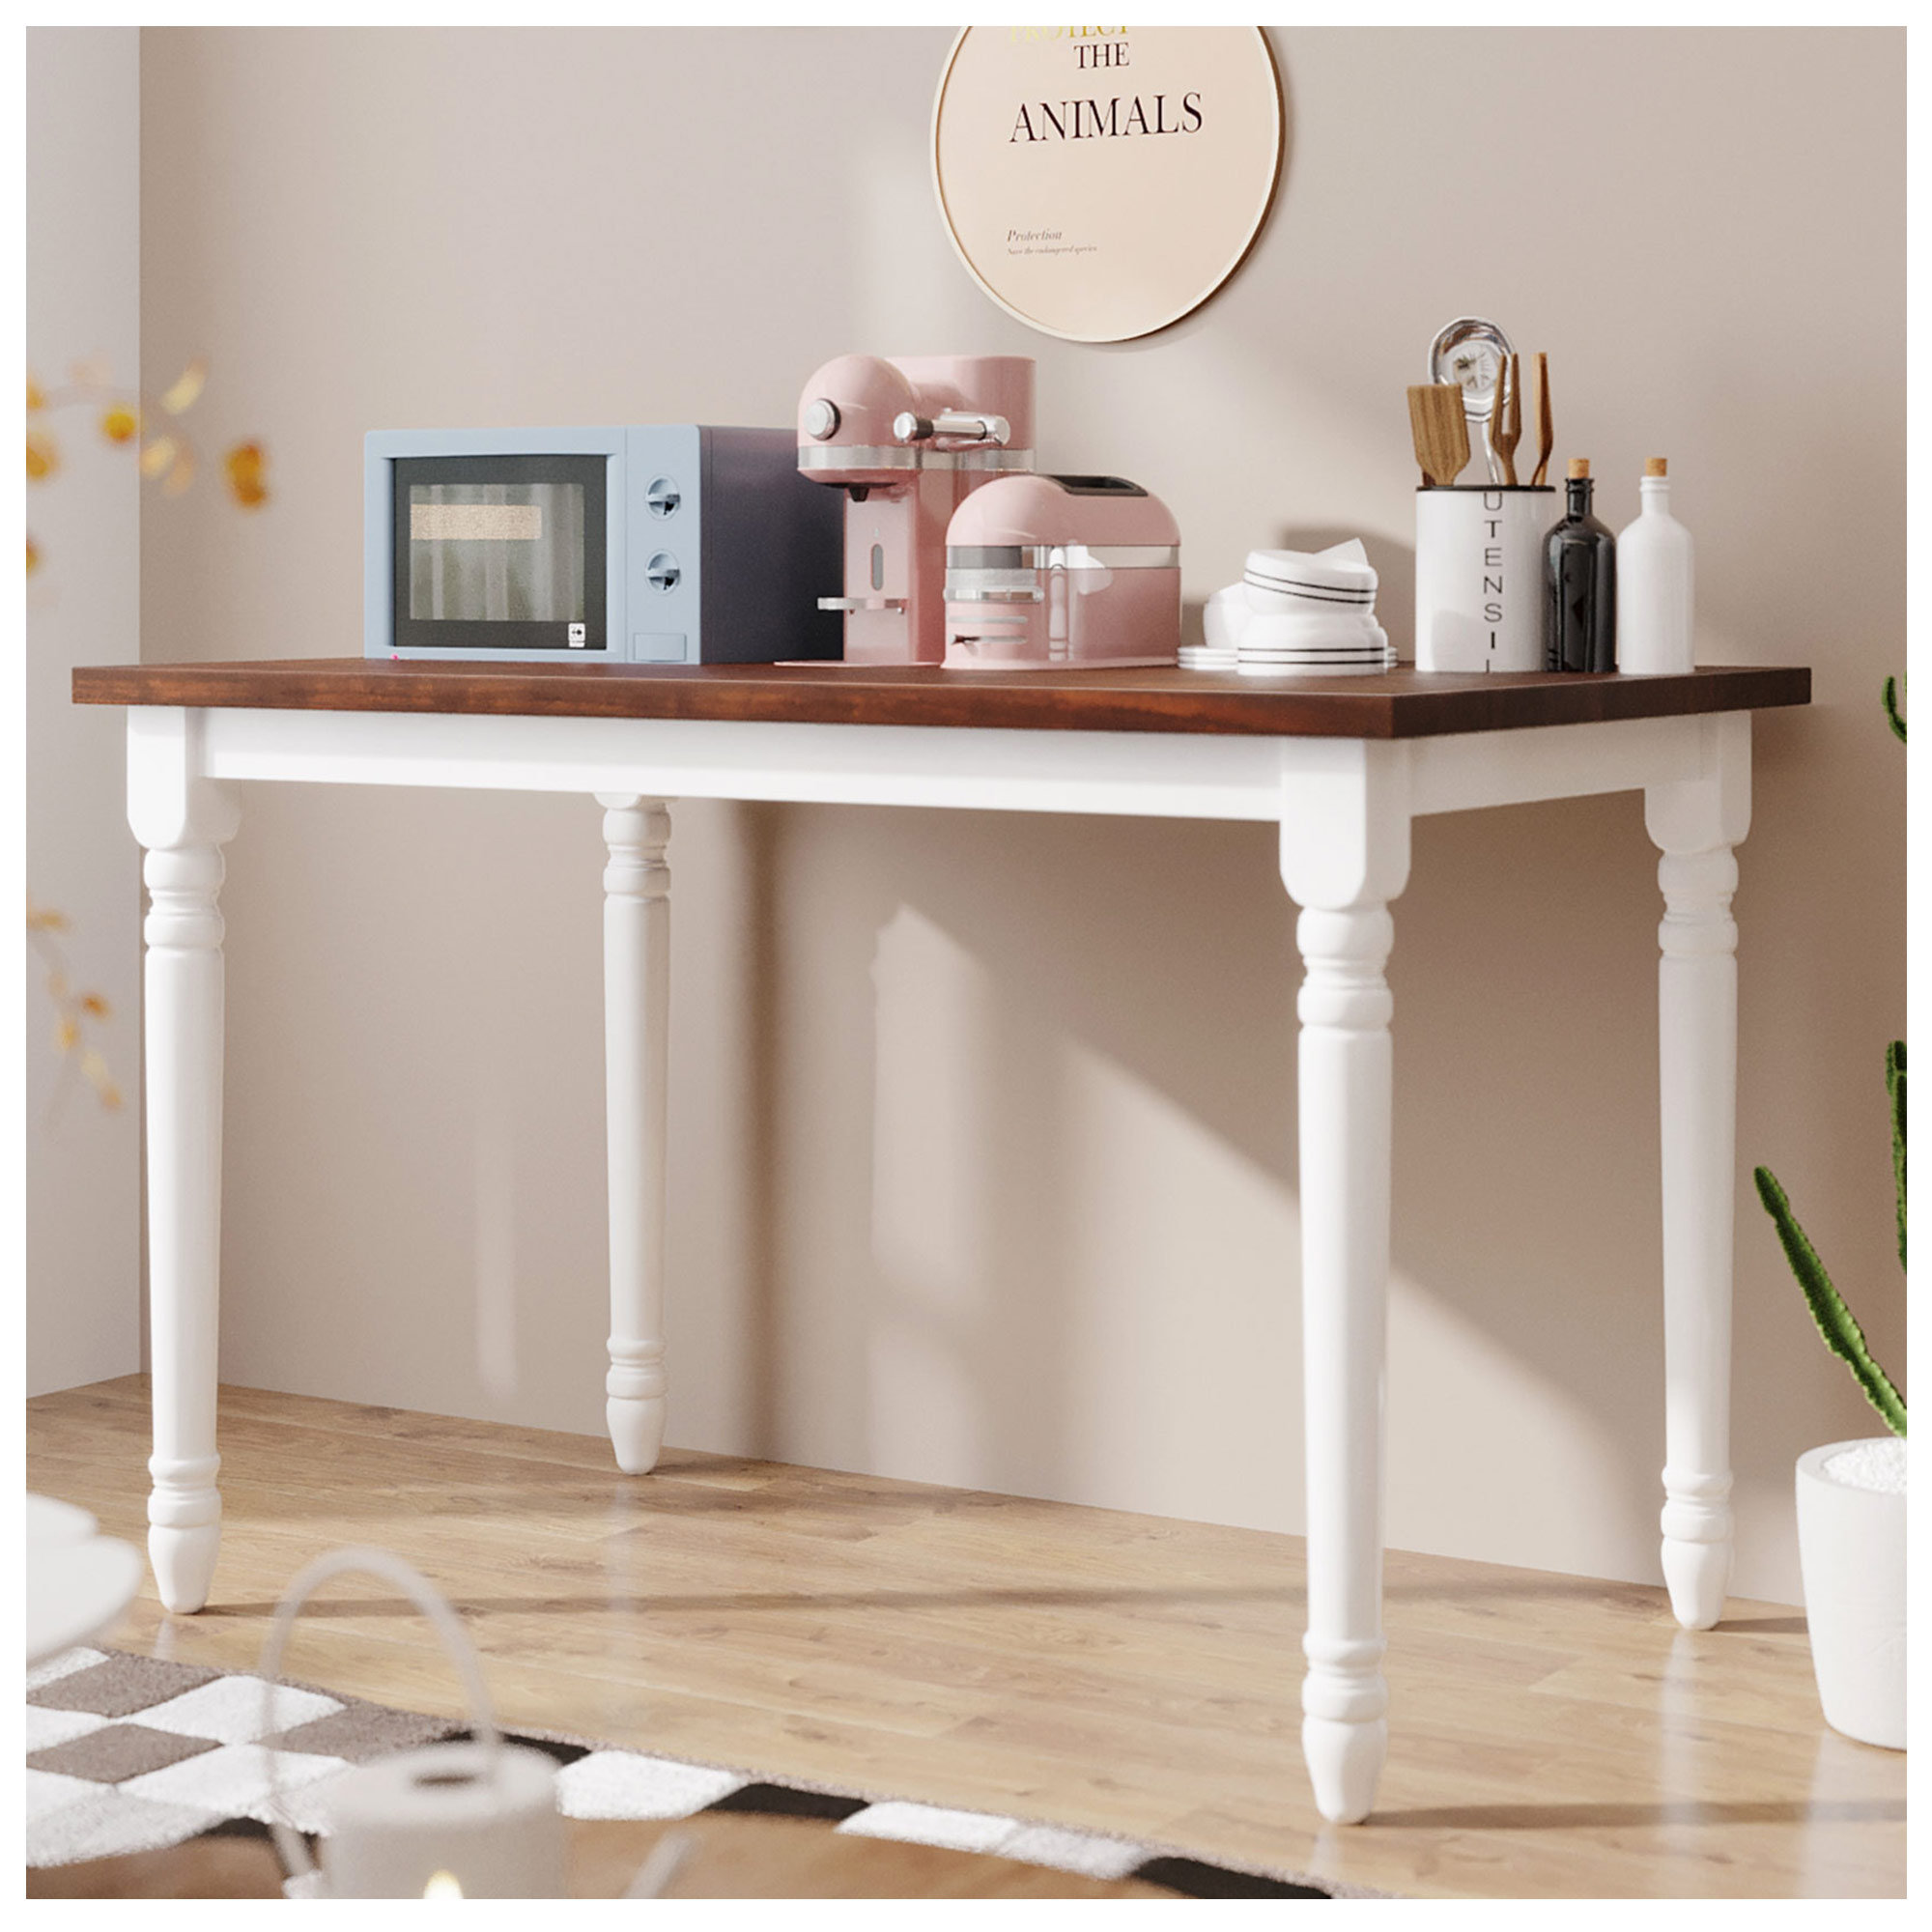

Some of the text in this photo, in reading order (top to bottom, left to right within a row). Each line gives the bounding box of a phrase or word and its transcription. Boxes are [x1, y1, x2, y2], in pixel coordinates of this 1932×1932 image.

[1073, 43, 1129, 69] THE
[1009, 91, 1204, 143] ANIMALS
[1008, 228, 1063, 242] Protection
